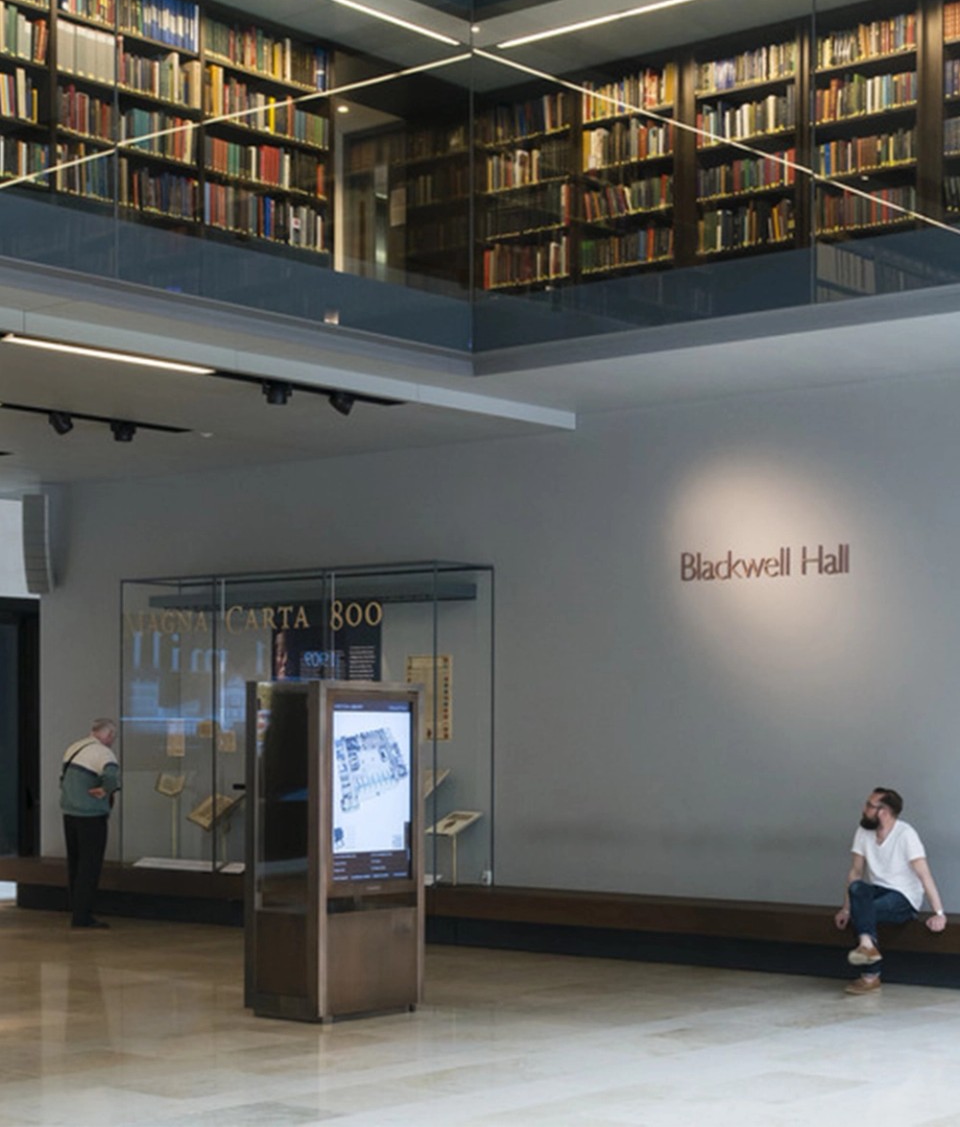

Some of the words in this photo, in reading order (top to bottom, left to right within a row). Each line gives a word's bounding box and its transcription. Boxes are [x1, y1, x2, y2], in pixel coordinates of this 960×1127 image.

[680, 546, 790, 581] Blackwell
[801, 543, 850, 575] Hall
[124, 609, 209, 637] MAGNA
[226, 605, 310, 635] CARTA
[330, 600, 384, 631] 800
